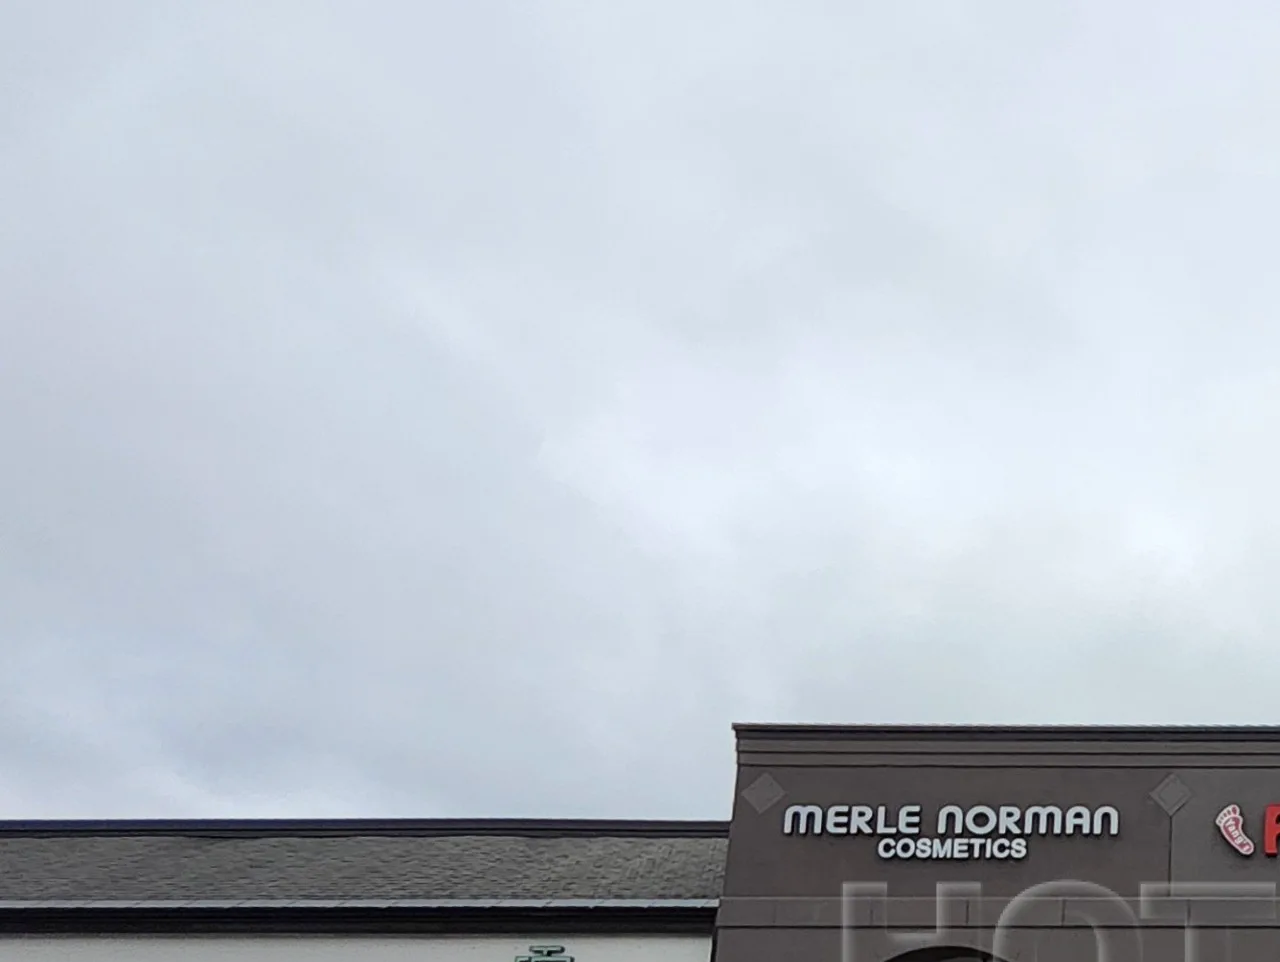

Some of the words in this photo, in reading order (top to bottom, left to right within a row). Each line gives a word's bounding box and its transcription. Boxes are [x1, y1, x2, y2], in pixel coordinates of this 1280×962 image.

[783, 804, 921, 836] MERLE
[938, 805, 1120, 837] NORMAN
[1224, 818, 1251, 852] Yang's
[878, 837, 1028, 860] COSMETICS
